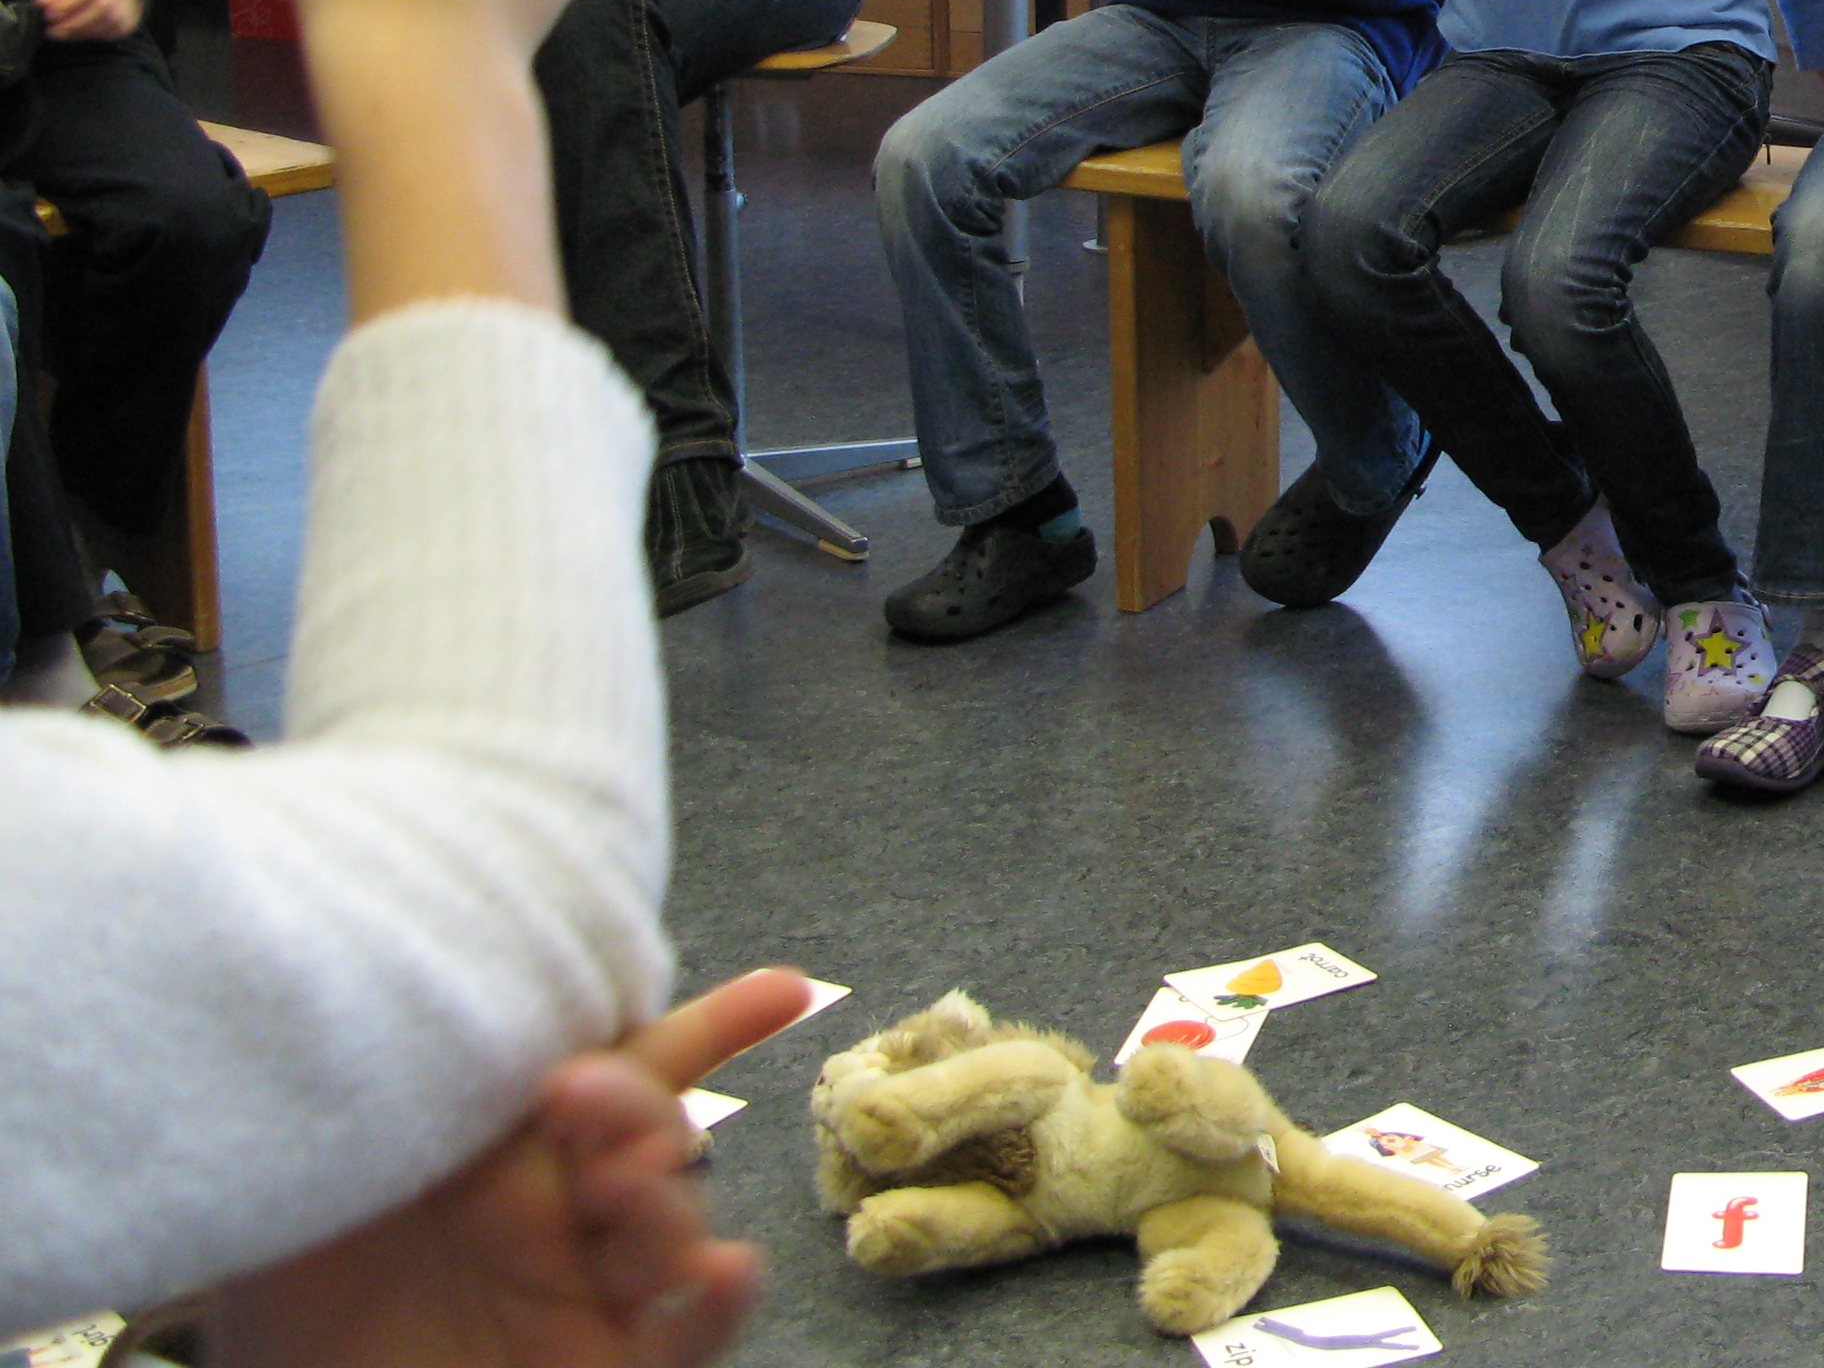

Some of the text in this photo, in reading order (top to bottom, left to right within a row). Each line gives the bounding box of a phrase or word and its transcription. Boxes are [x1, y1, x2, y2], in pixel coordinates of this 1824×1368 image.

[1298, 951, 1350, 980] carrot
[1442, 1162, 1502, 1192] nurse
[1711, 1195, 1761, 1250] f
[1223, 1341, 1258, 1367] zip
